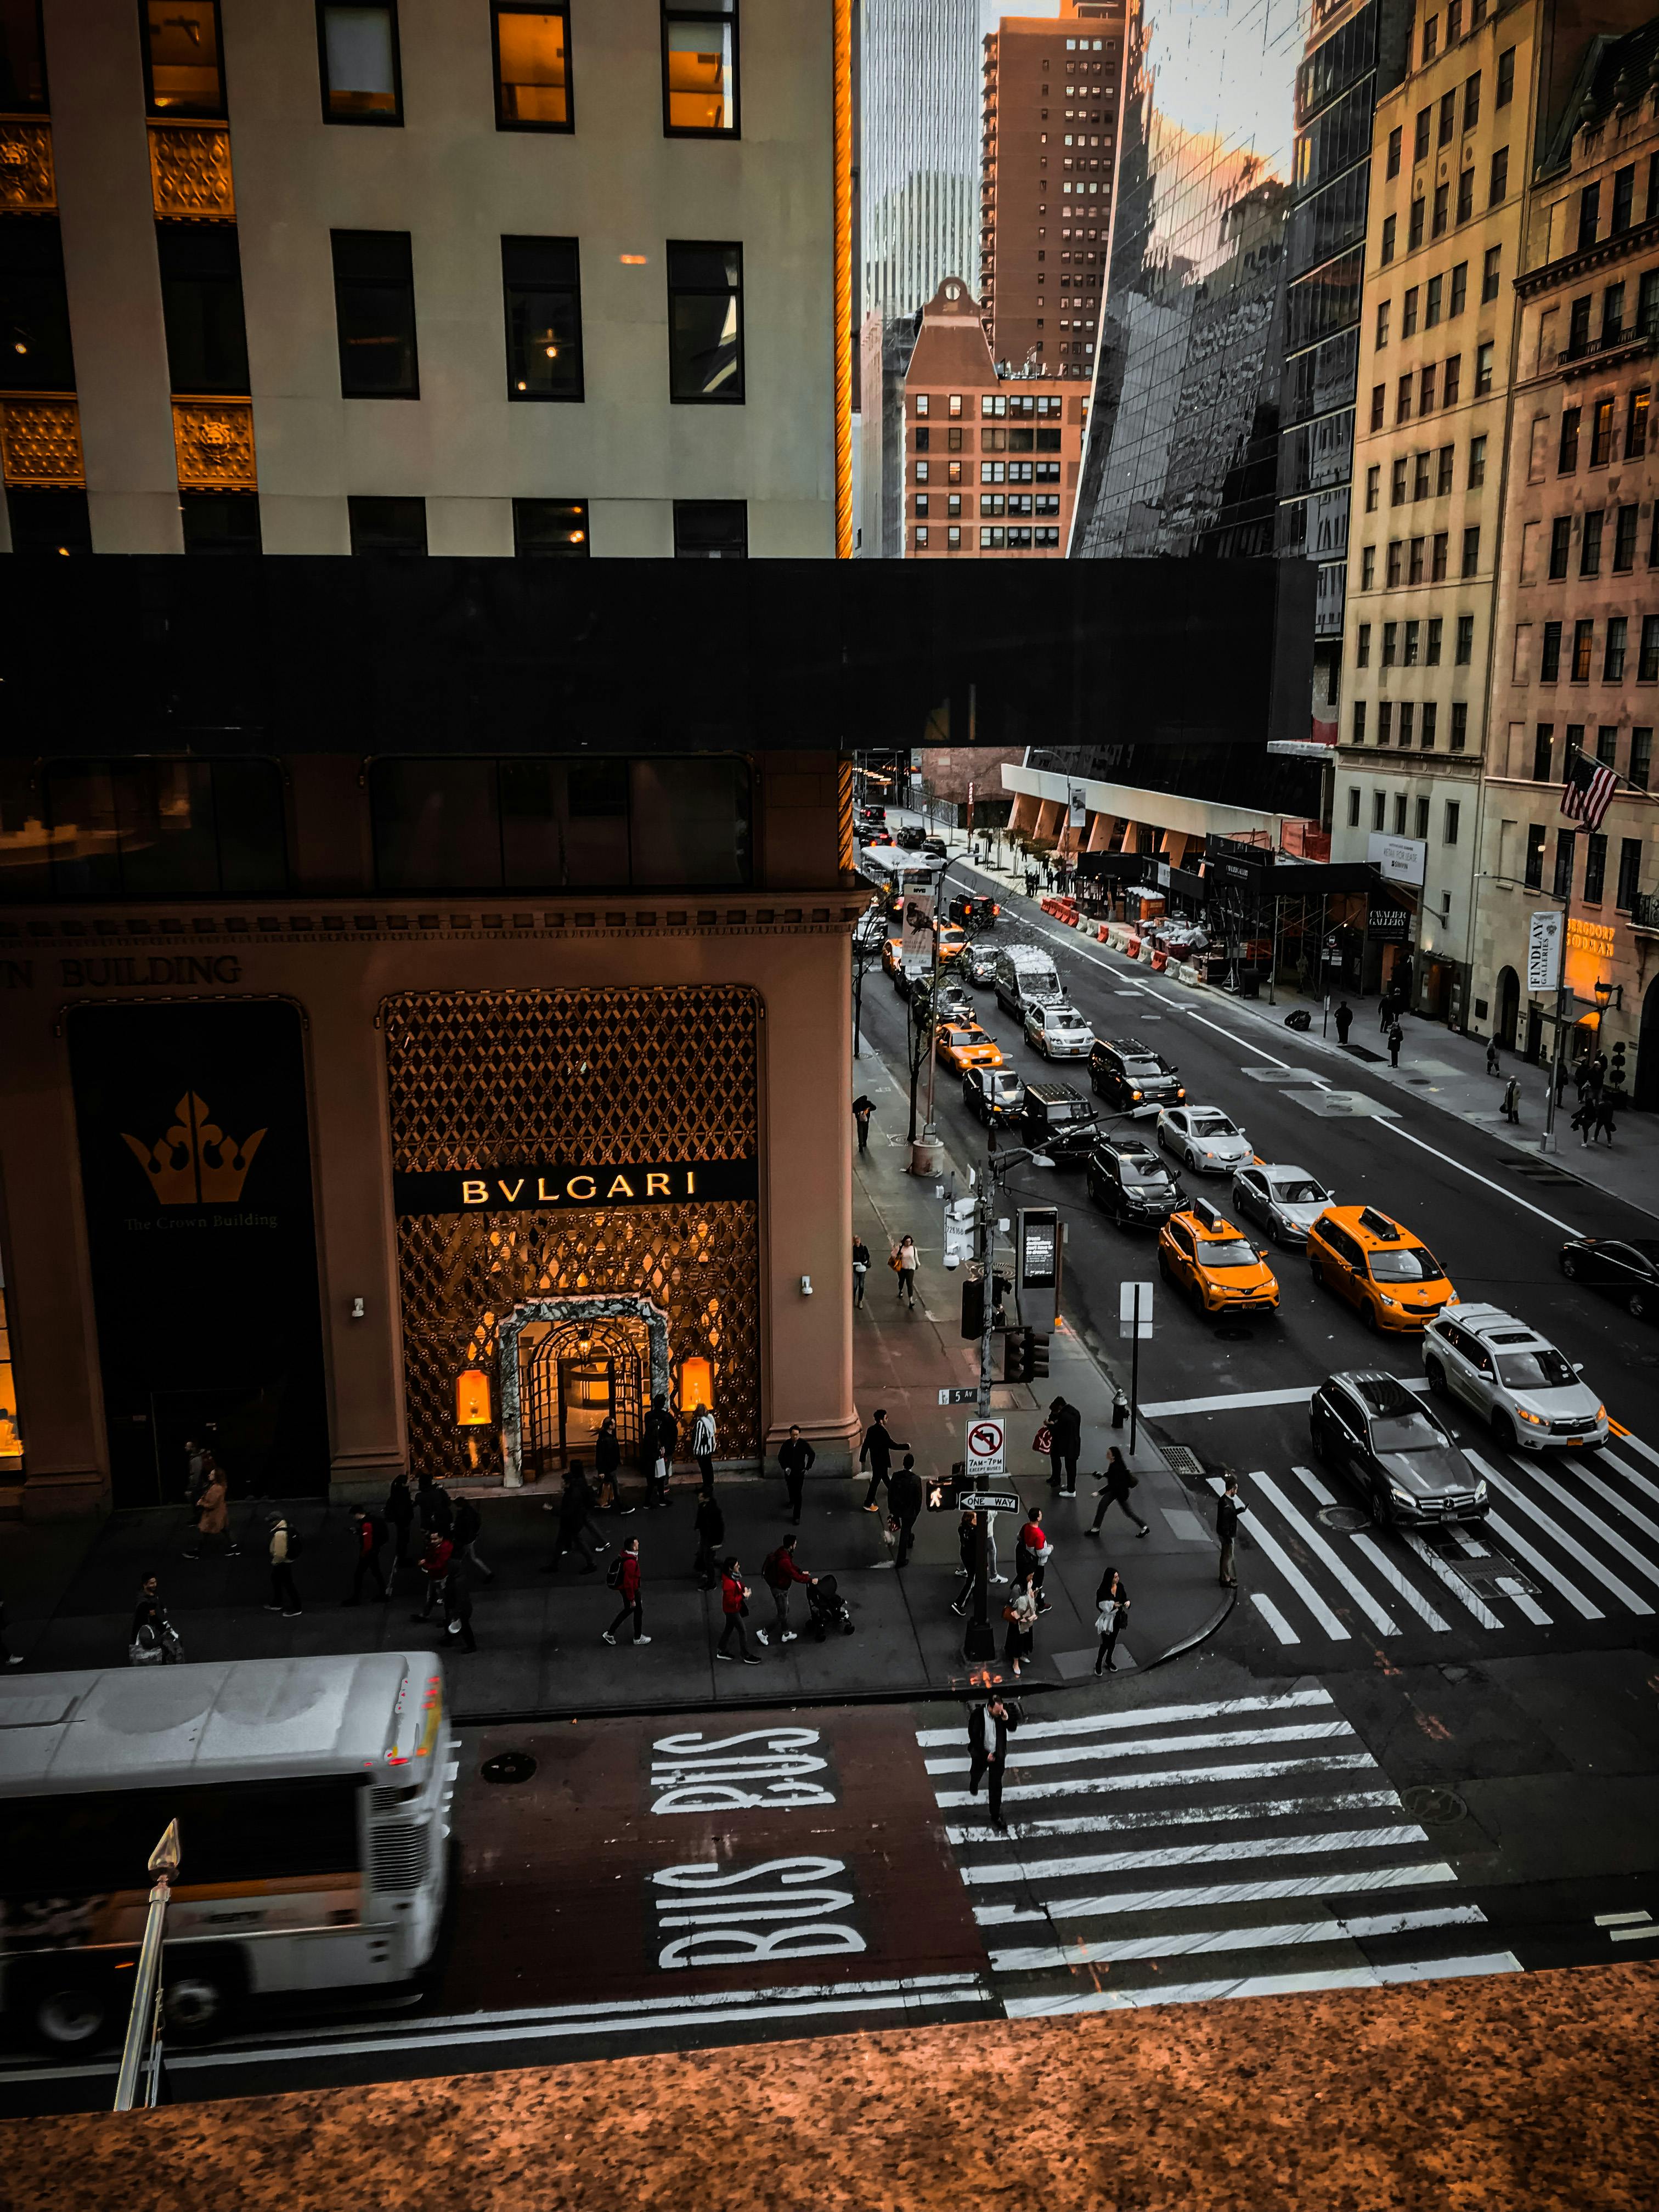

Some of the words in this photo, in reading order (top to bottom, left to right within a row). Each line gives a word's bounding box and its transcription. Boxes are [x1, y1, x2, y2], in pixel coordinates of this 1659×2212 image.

[1369, 918, 1407, 926] GALLERY
[1530, 922, 1543, 985] FINDLAY
[1541, 938, 1549, 985] GALLERIES
[59, 955, 242, 988] BUILDING
[461, 1171, 697, 1205] BVLGARI
[123, 1218, 151, 1231] The
[156, 1217, 207, 1229] Crown
[213, 1212, 278, 1229] Building
[955, 1391, 961, 1402] 5
[967, 1497, 985, 1505] ONE
[995, 1498, 1013, 1507] WAY
[651, 1726, 837, 1815] BUS
[653, 1855, 867, 1970] BUS
